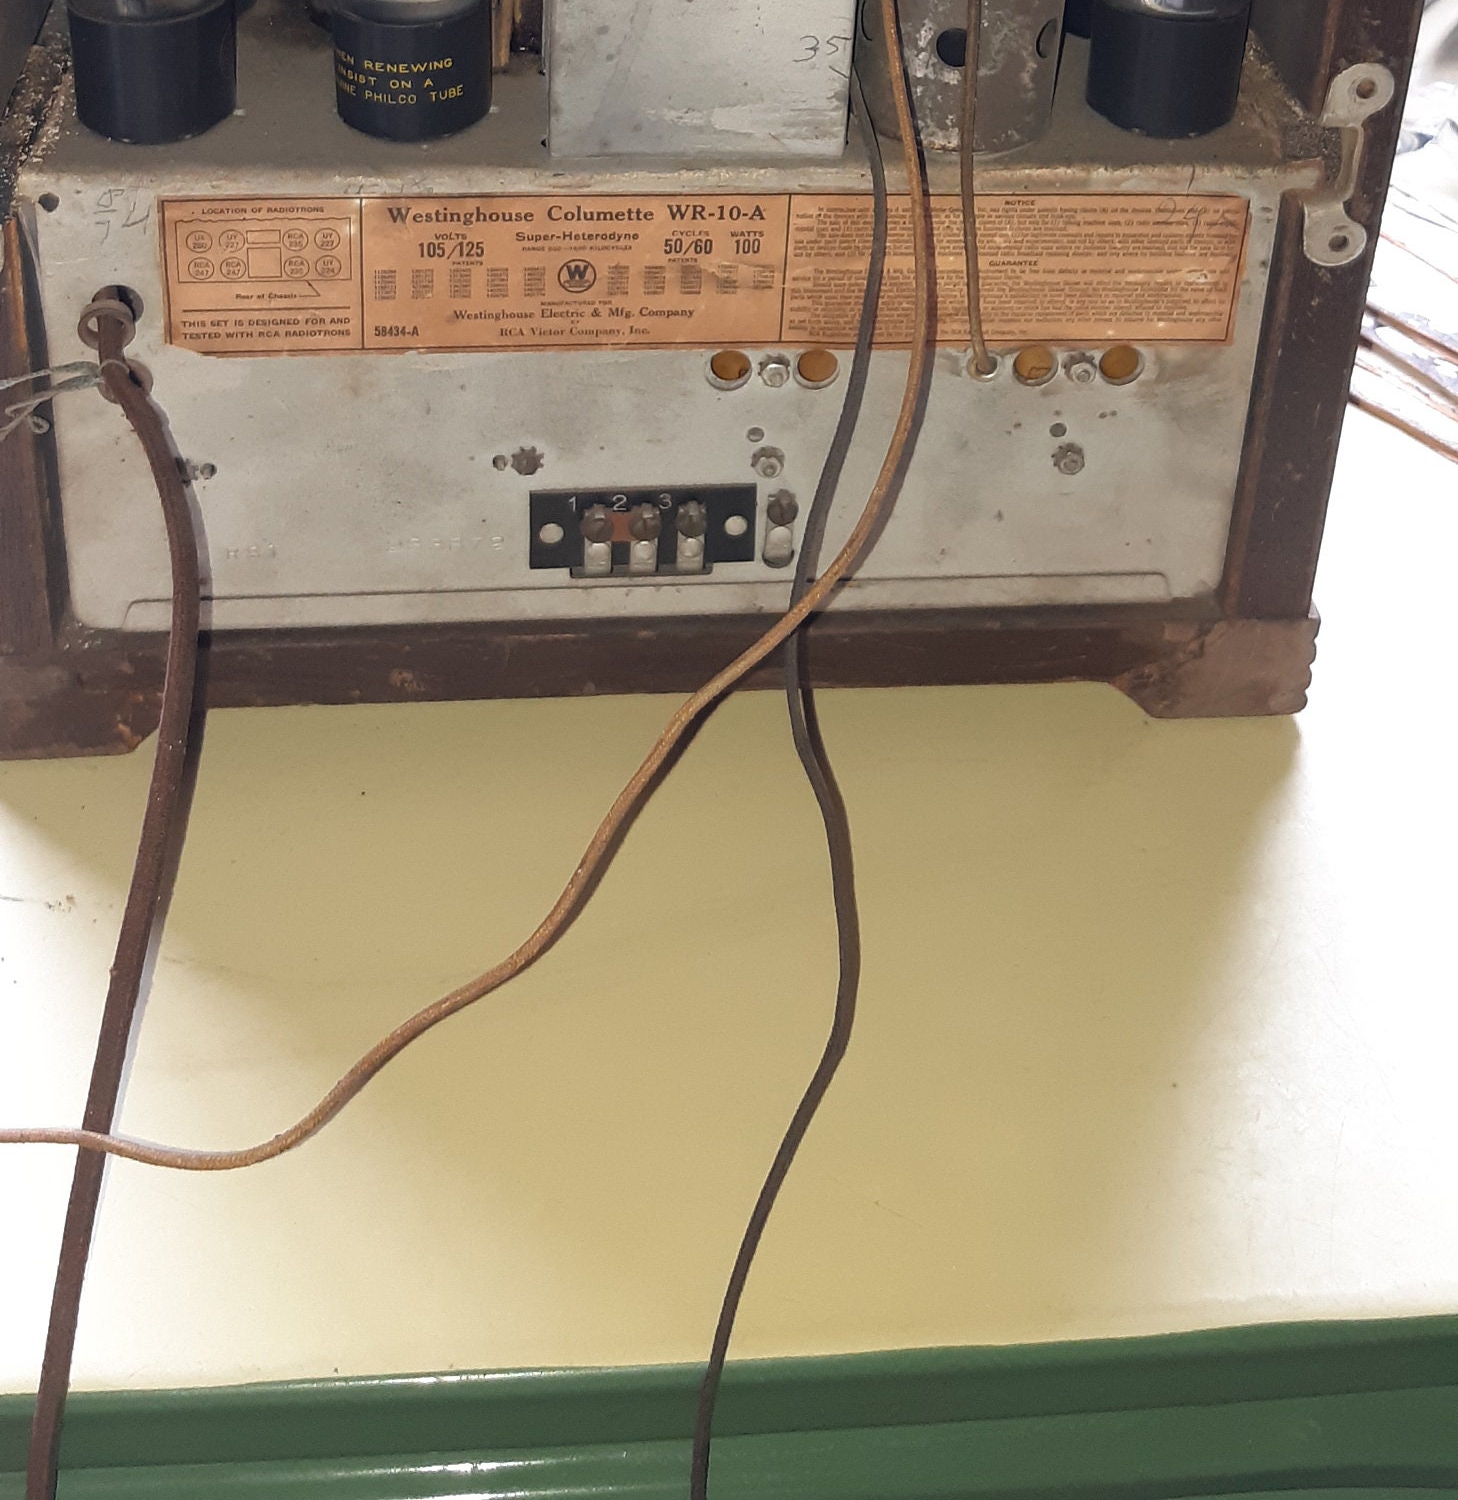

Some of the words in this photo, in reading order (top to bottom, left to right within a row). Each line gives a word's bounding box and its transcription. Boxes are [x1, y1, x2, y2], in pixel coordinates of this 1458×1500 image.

[364, 58, 453, 74] RENEWING
[389, 79, 412, 90] ON
[423, 78, 434, 88] A
[365, 91, 417, 104] PHILCO
[430, 84, 464, 101] TUBE
[1004, 199, 1036, 207] NOTICE
[202, 207, 247, 215] LOCATION
[267, 206, 324, 214] RADIOTRONS
[387, 206, 535, 226] Westinghouse
[547, 205, 654, 222] Columette
[667, 204, 766, 221] WR-10-A
[434, 232, 467, 240] VOLTS
[515, 231, 640, 243] Super-Heterodyne
[730, 230, 764, 238] WATTS
[418, 241, 485, 260] 105/125
[664, 238, 713, 255] 50/60
[735, 238, 761, 255] 100
[566, 264, 589, 281] W
[453, 309, 535, 321] Westinghouse
[541, 308, 585, 318] Electric
[591, 308, 602, 318] &
[608, 307, 635, 319] Mfg.
[639, 307, 695, 319] Company
[248, 318, 300, 326] DESIGNED
[305, 317, 326, 325] FOR
[182, 332, 221, 340] TESTED
[225, 331, 253, 339] WITH
[285, 329, 351, 338] RADIOTRONS
[374, 325, 419, 337] 58434-A
[500, 327, 524, 338] RCA
[530, 327, 566, 337] Victor
[569, 326, 626, 338] Company,
[629, 325, 651, 335] Inc.
[568, 495, 577, 511] 1
[612, 494, 629, 511] 2
[658, 493, 673, 510] 3
